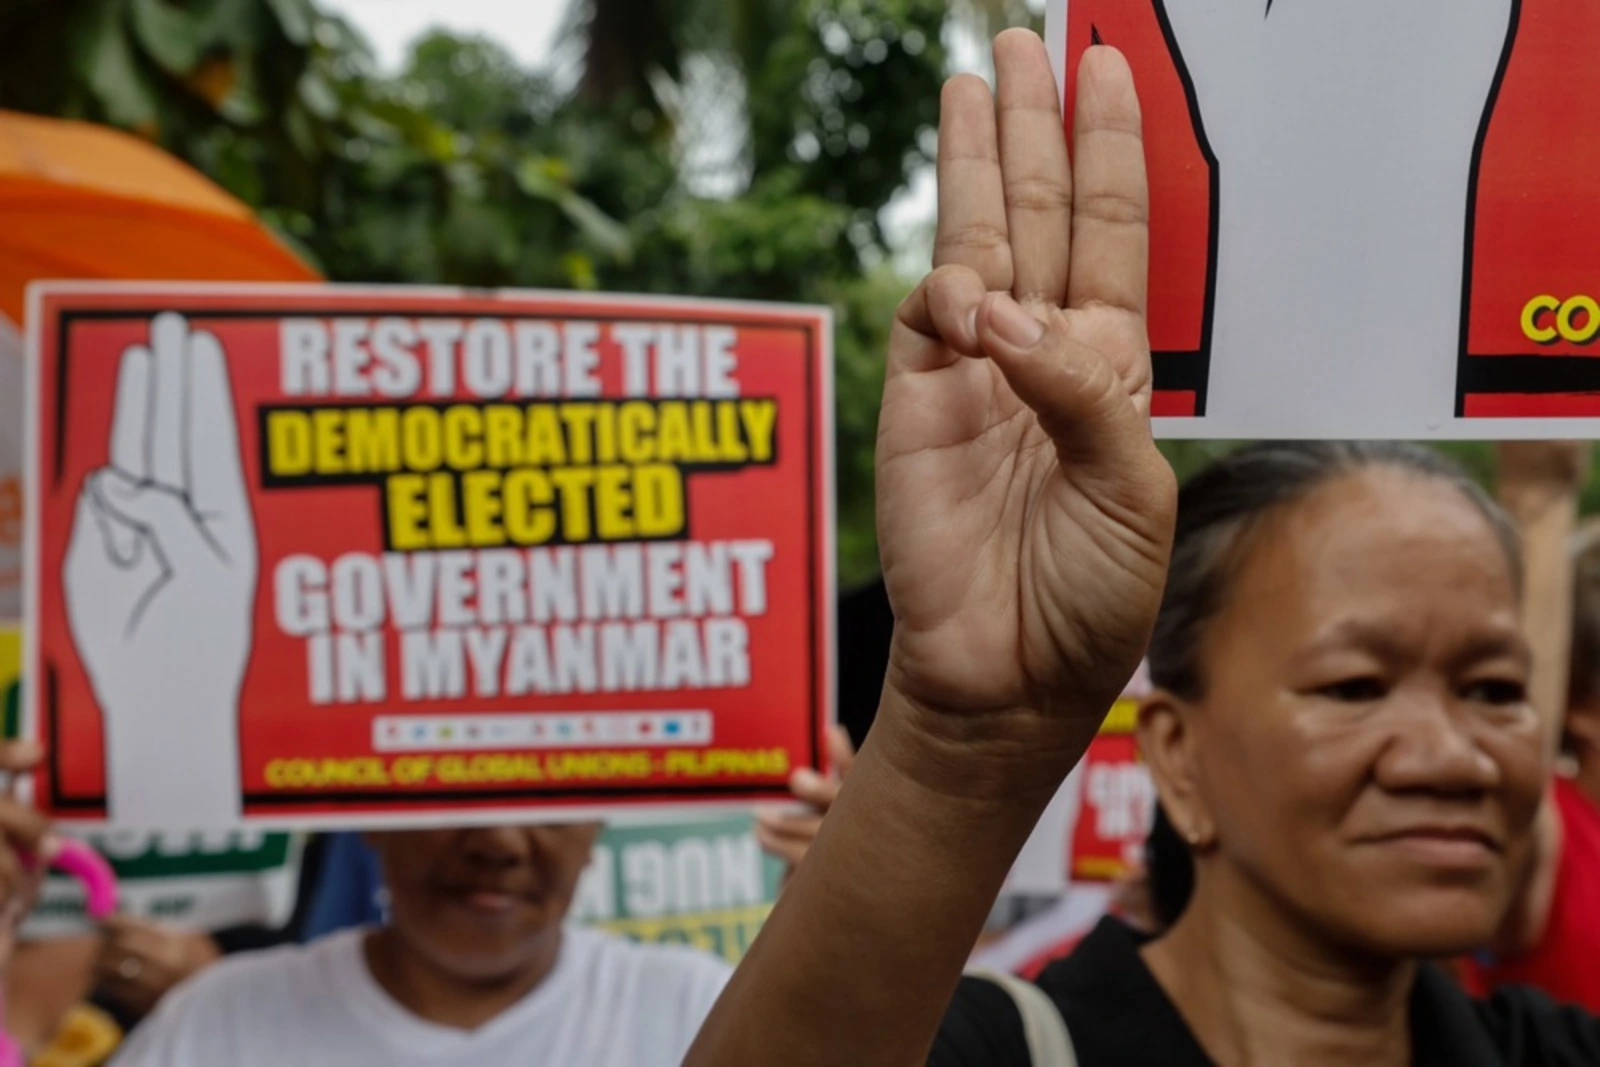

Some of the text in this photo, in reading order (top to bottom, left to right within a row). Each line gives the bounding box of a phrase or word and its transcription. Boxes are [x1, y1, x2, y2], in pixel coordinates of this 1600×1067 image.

[278, 317, 740, 398] RESTORE THE
[267, 400, 778, 476] DEMOCRATICALLY
[387, 463, 686, 550] ELECTED
[273, 540, 774, 637] GOVERNMENT
[308, 618, 752, 705] IN MYANMAR
[264, 757, 388, 787] COUNCIL
[393, 757, 434, 783] OF
[437, 753, 547, 781] GLOBAL
[547, 751, 650, 778] UNIONS
[666, 748, 788, 776] PILIPINAS
